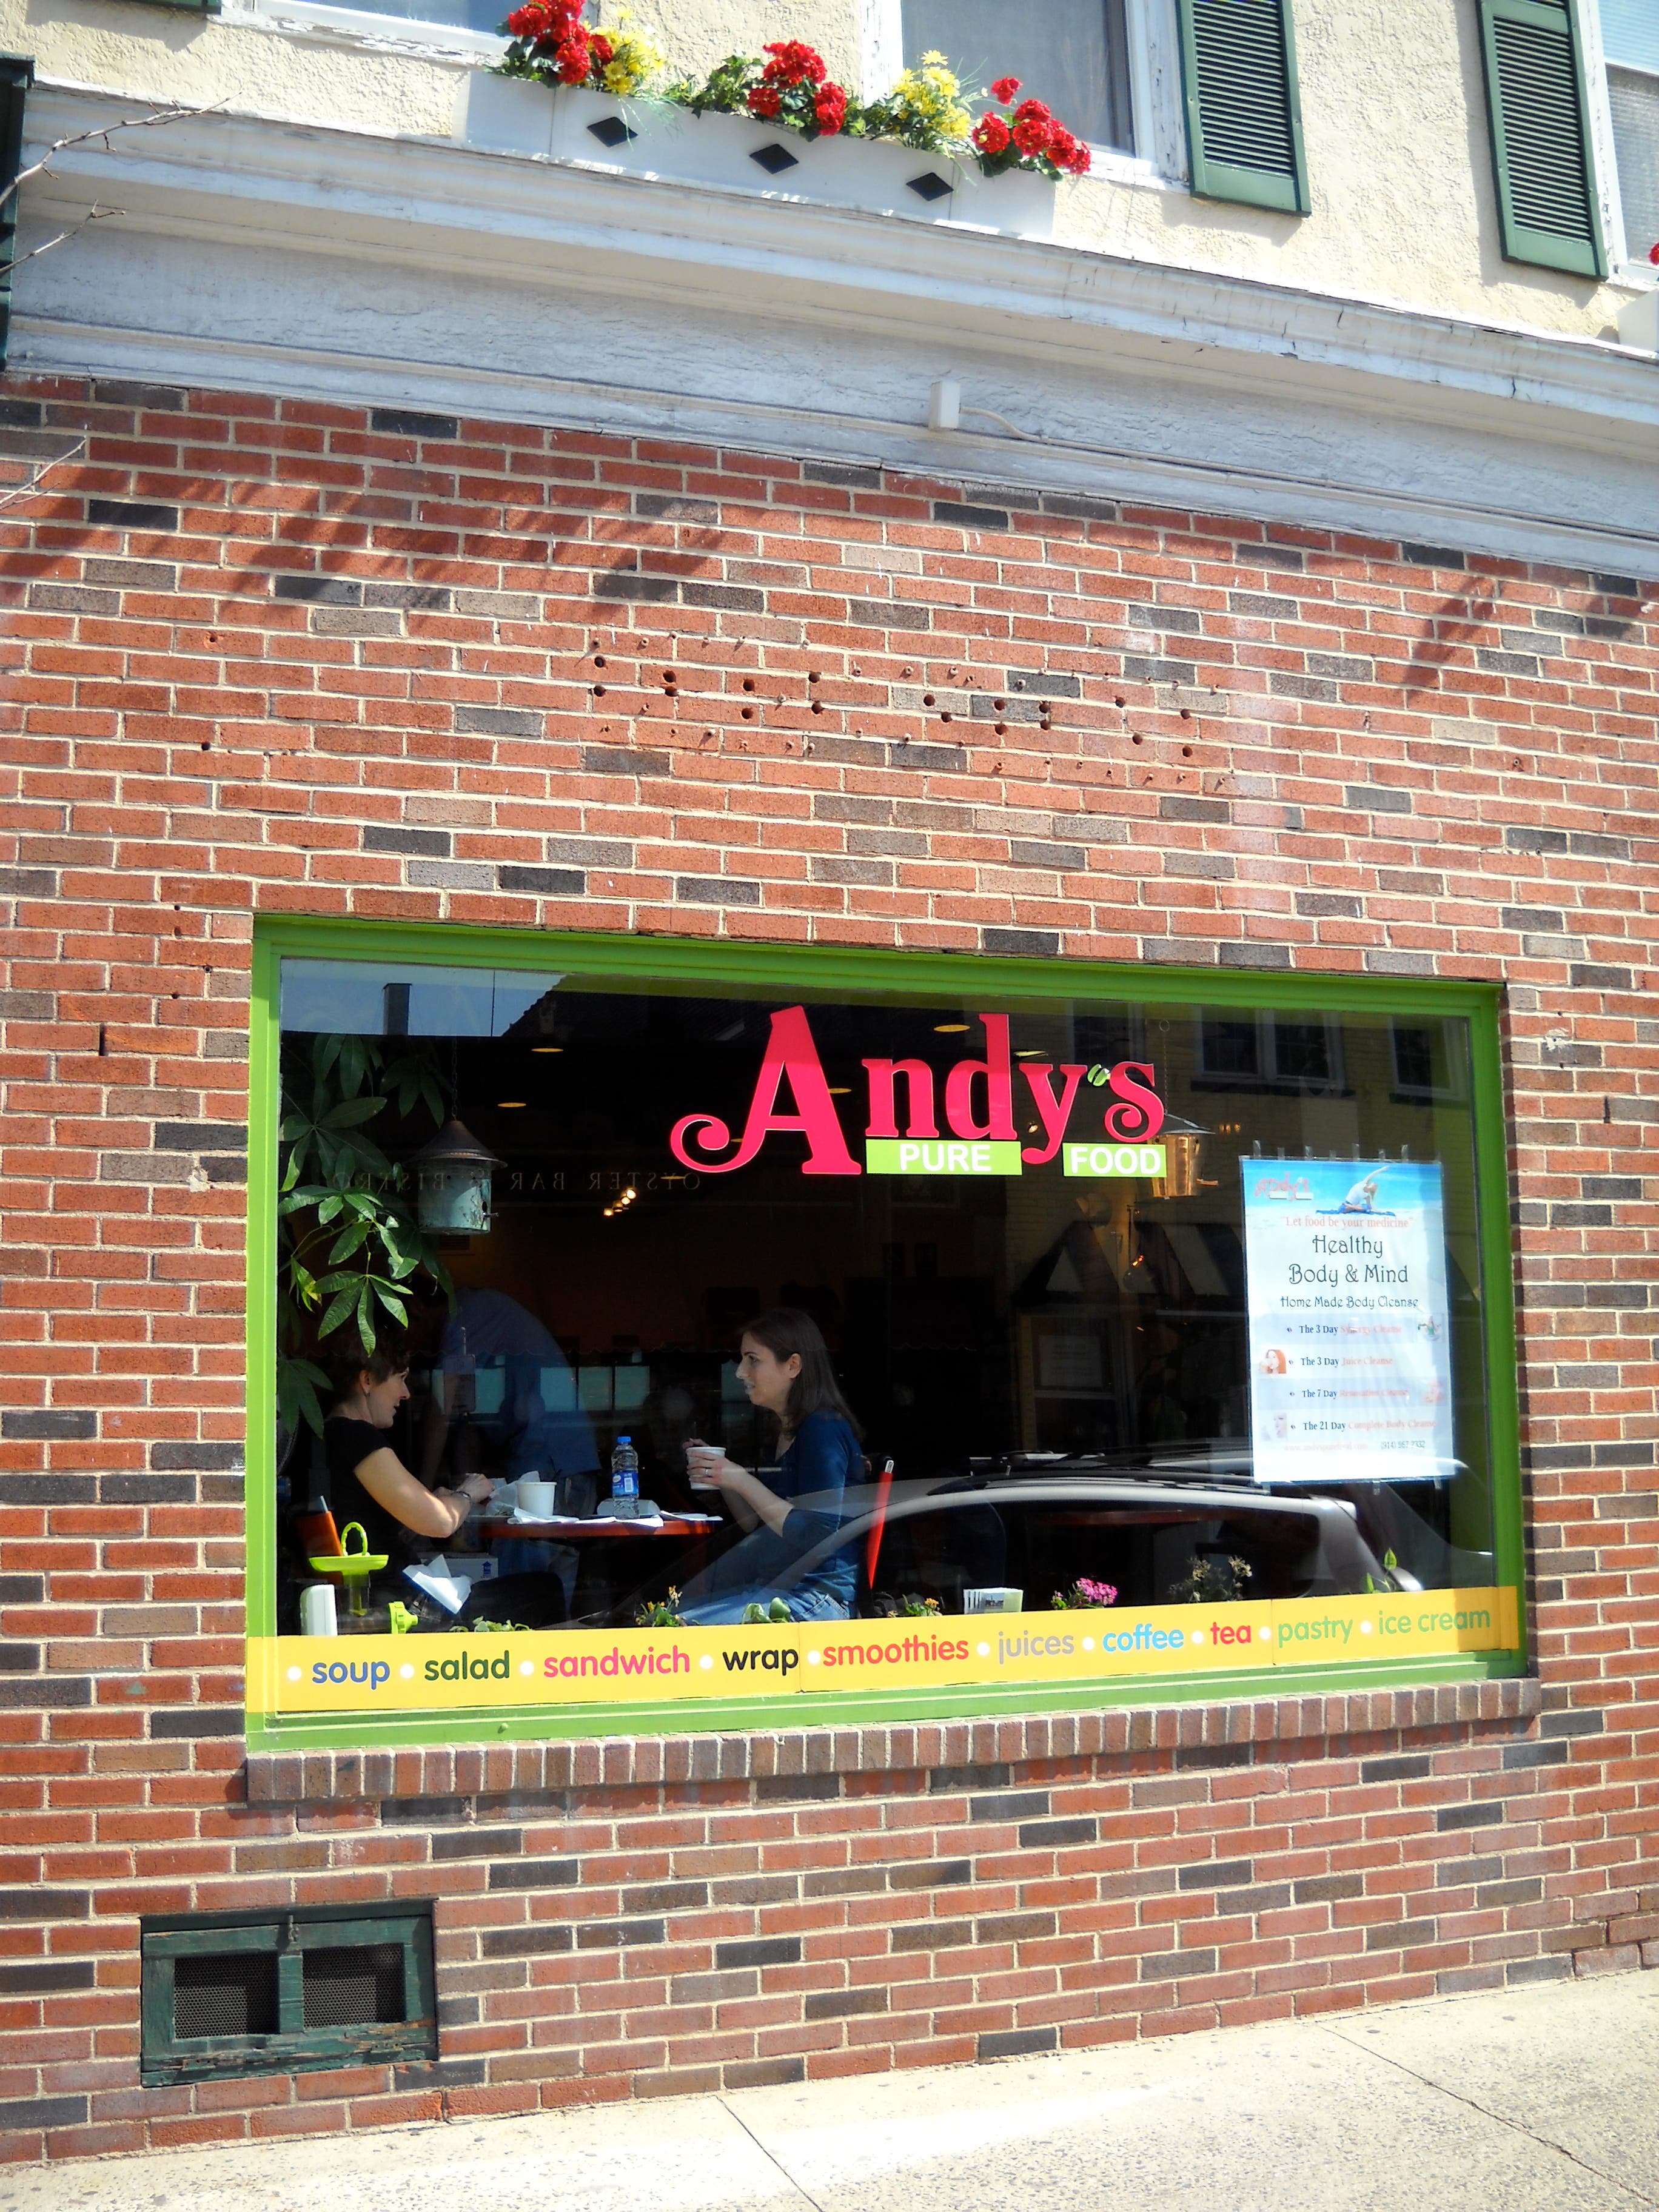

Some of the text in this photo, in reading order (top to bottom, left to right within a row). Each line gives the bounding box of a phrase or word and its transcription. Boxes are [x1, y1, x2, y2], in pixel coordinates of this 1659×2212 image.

[670, 1005, 1165, 1174] Andy's
[899, 1144, 1162, 1175] PURE FOOD
[1305, 1216, 1326, 1227] food
[1328, 1216, 1339, 1227] be
[1342, 1218, 1364, 1230] your
[1312, 1235, 1383, 1258] Healthy
[1289, 1264, 1409, 1287] Body & Mind
[1281, 1296, 1419, 1310] Home Made Body Cleanse
[1299, 1325, 1315, 1333] The
[1316, 1324, 1321, 1333] 3
[1322, 1325, 1338, 1335] Day
[1301, 1355, 1393, 1368] The 3 Day Juice Cleanse
[1302, 1389, 1315, 1398] The
[1316, 1389, 1322, 1398] 7
[1323, 1389, 1338, 1400] Day
[1303, 1422, 1318, 1430] The
[1319, 1421, 1328, 1430] 21
[1330, 1422, 1346, 1432] Day
[1381, 1440, 1396, 1449] (914)
[312, 1609, 1490, 1690] soup salad sandwich wrap smoothies juices coffee tea pastry ice cream
